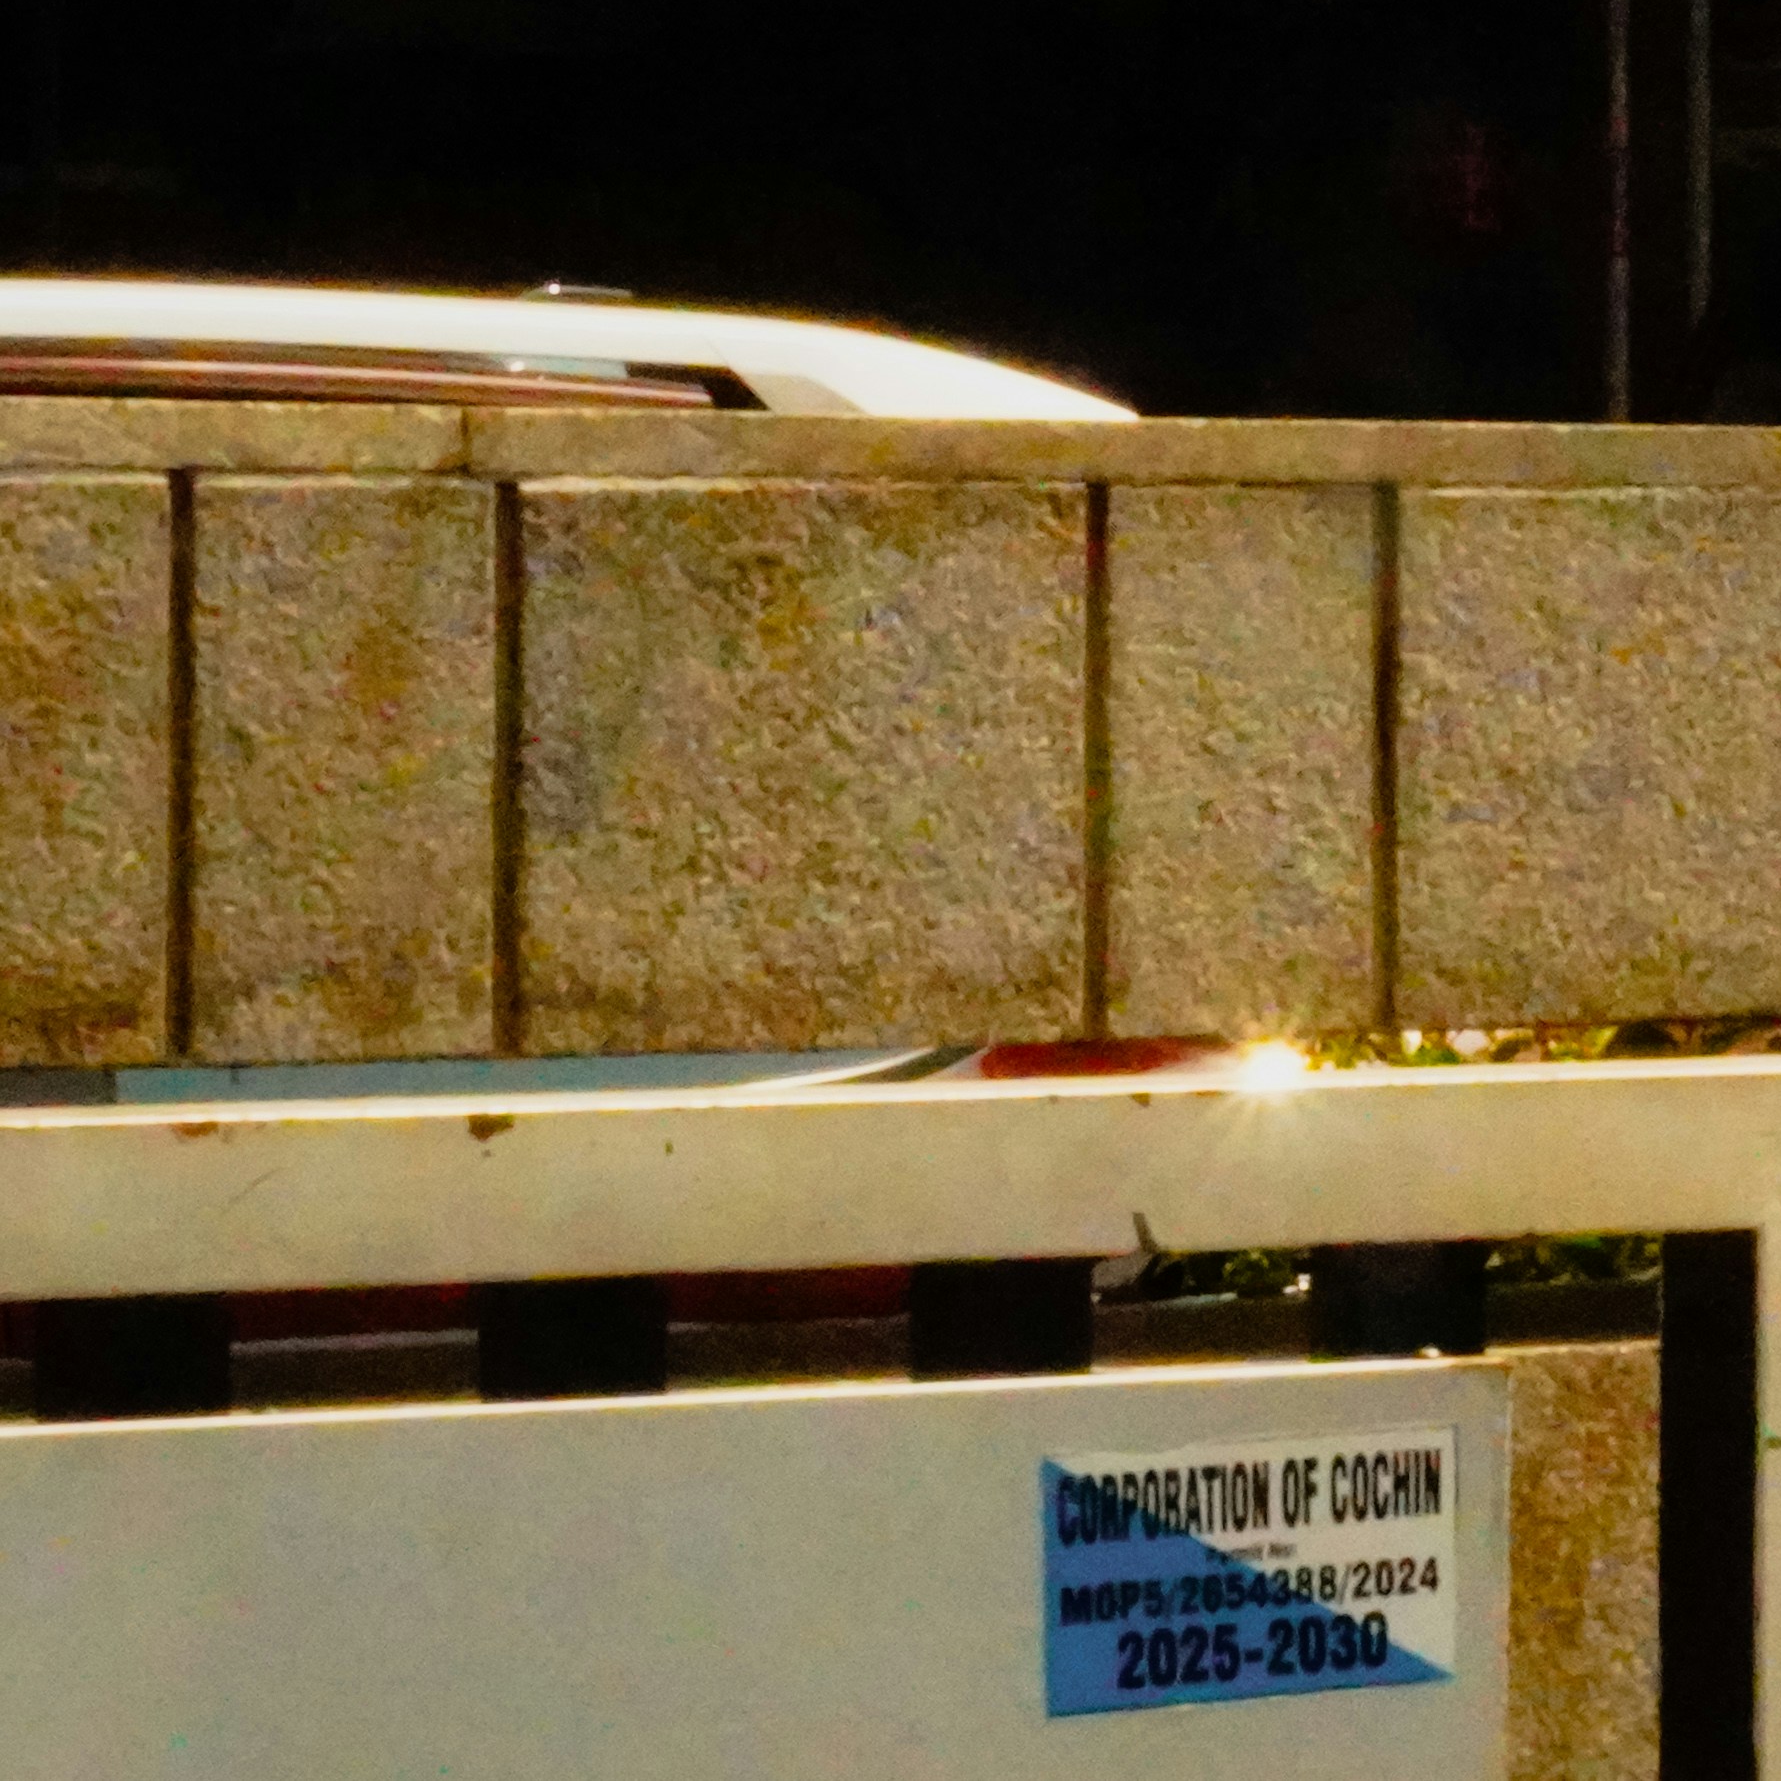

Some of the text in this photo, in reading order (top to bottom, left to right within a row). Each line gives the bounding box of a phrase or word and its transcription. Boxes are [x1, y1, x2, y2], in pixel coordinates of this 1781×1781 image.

[1056, 1448, 1441, 1546] CORPORATION OF COCHIN
[1116, 1611, 1389, 1690] 2025-2030
